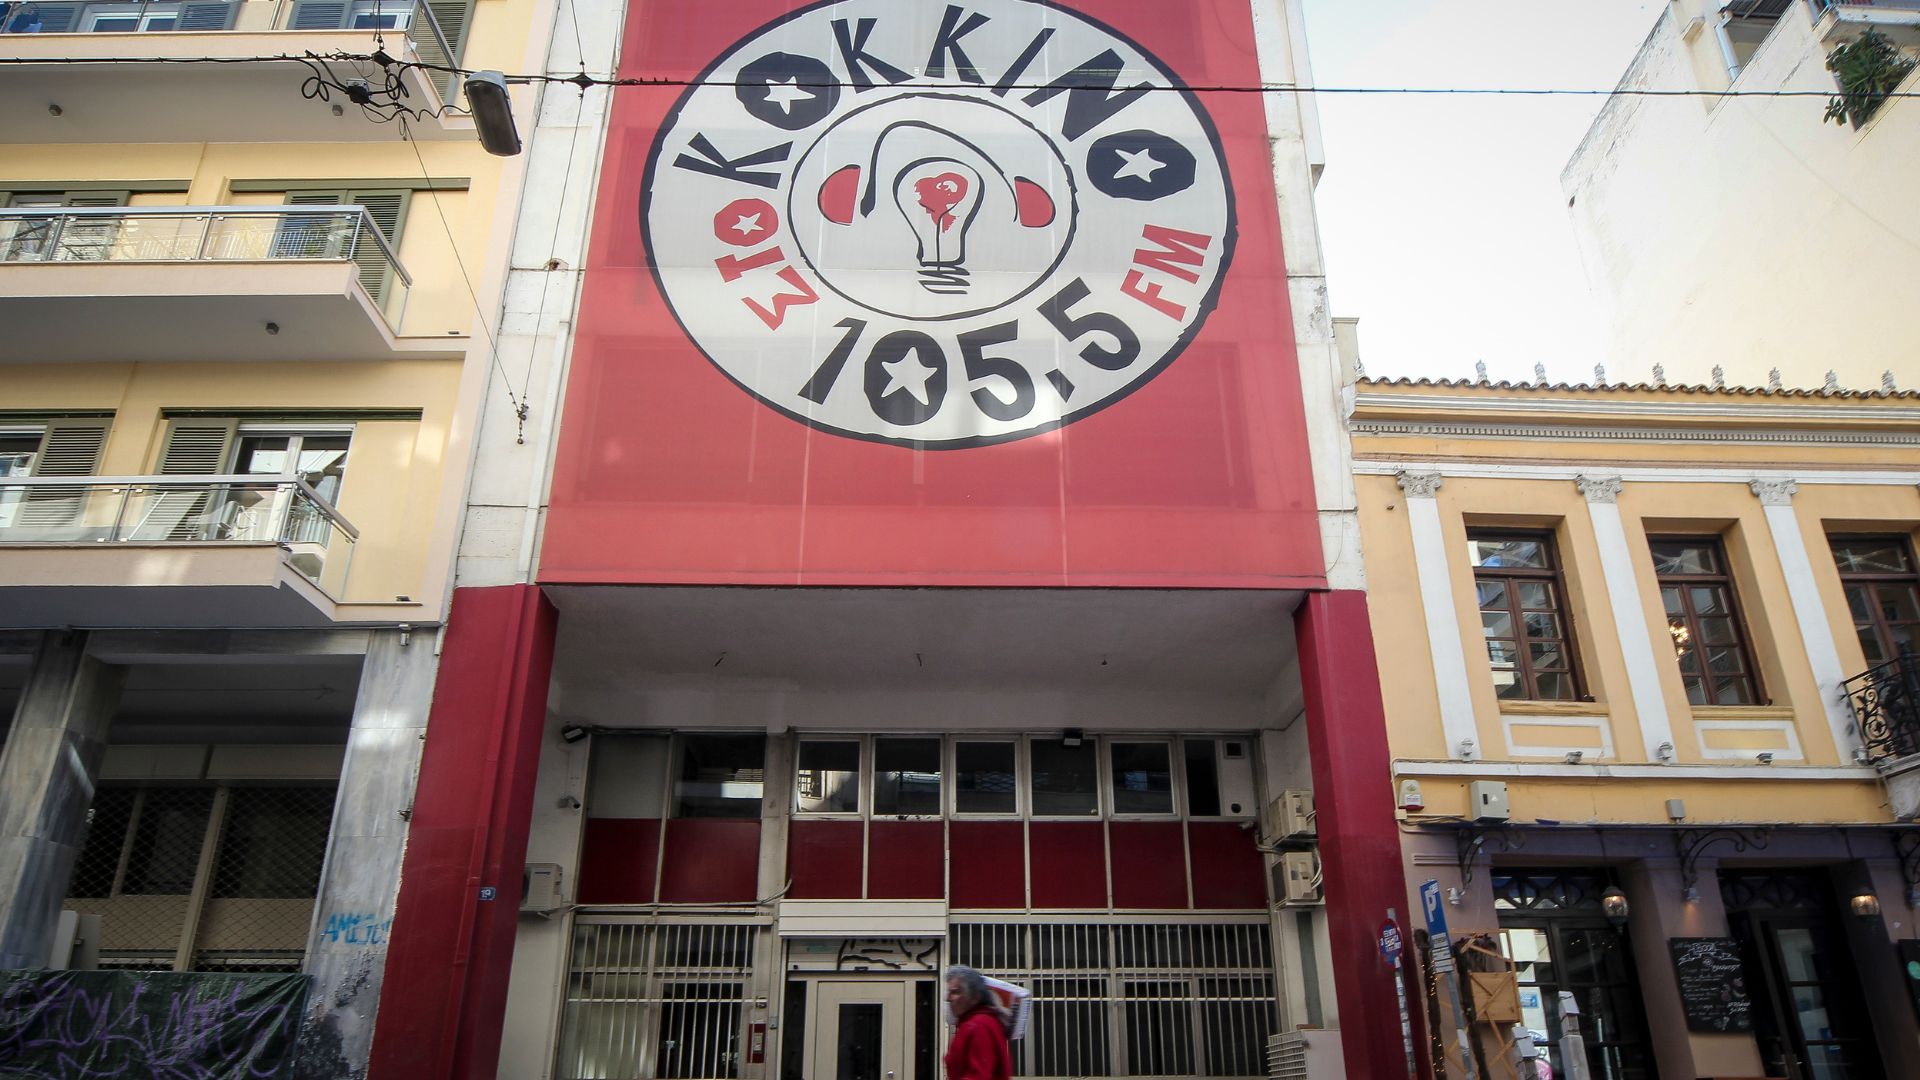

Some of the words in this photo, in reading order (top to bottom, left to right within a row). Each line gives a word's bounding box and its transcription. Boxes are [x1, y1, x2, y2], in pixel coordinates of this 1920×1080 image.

[673, 4, 1197, 201] ΚΟΚΚΙΝΟ
[713, 198, 820, 331] ΣΤΟ
[1119, 224, 1212, 322] FM
[480, 889, 491, 898] 19
